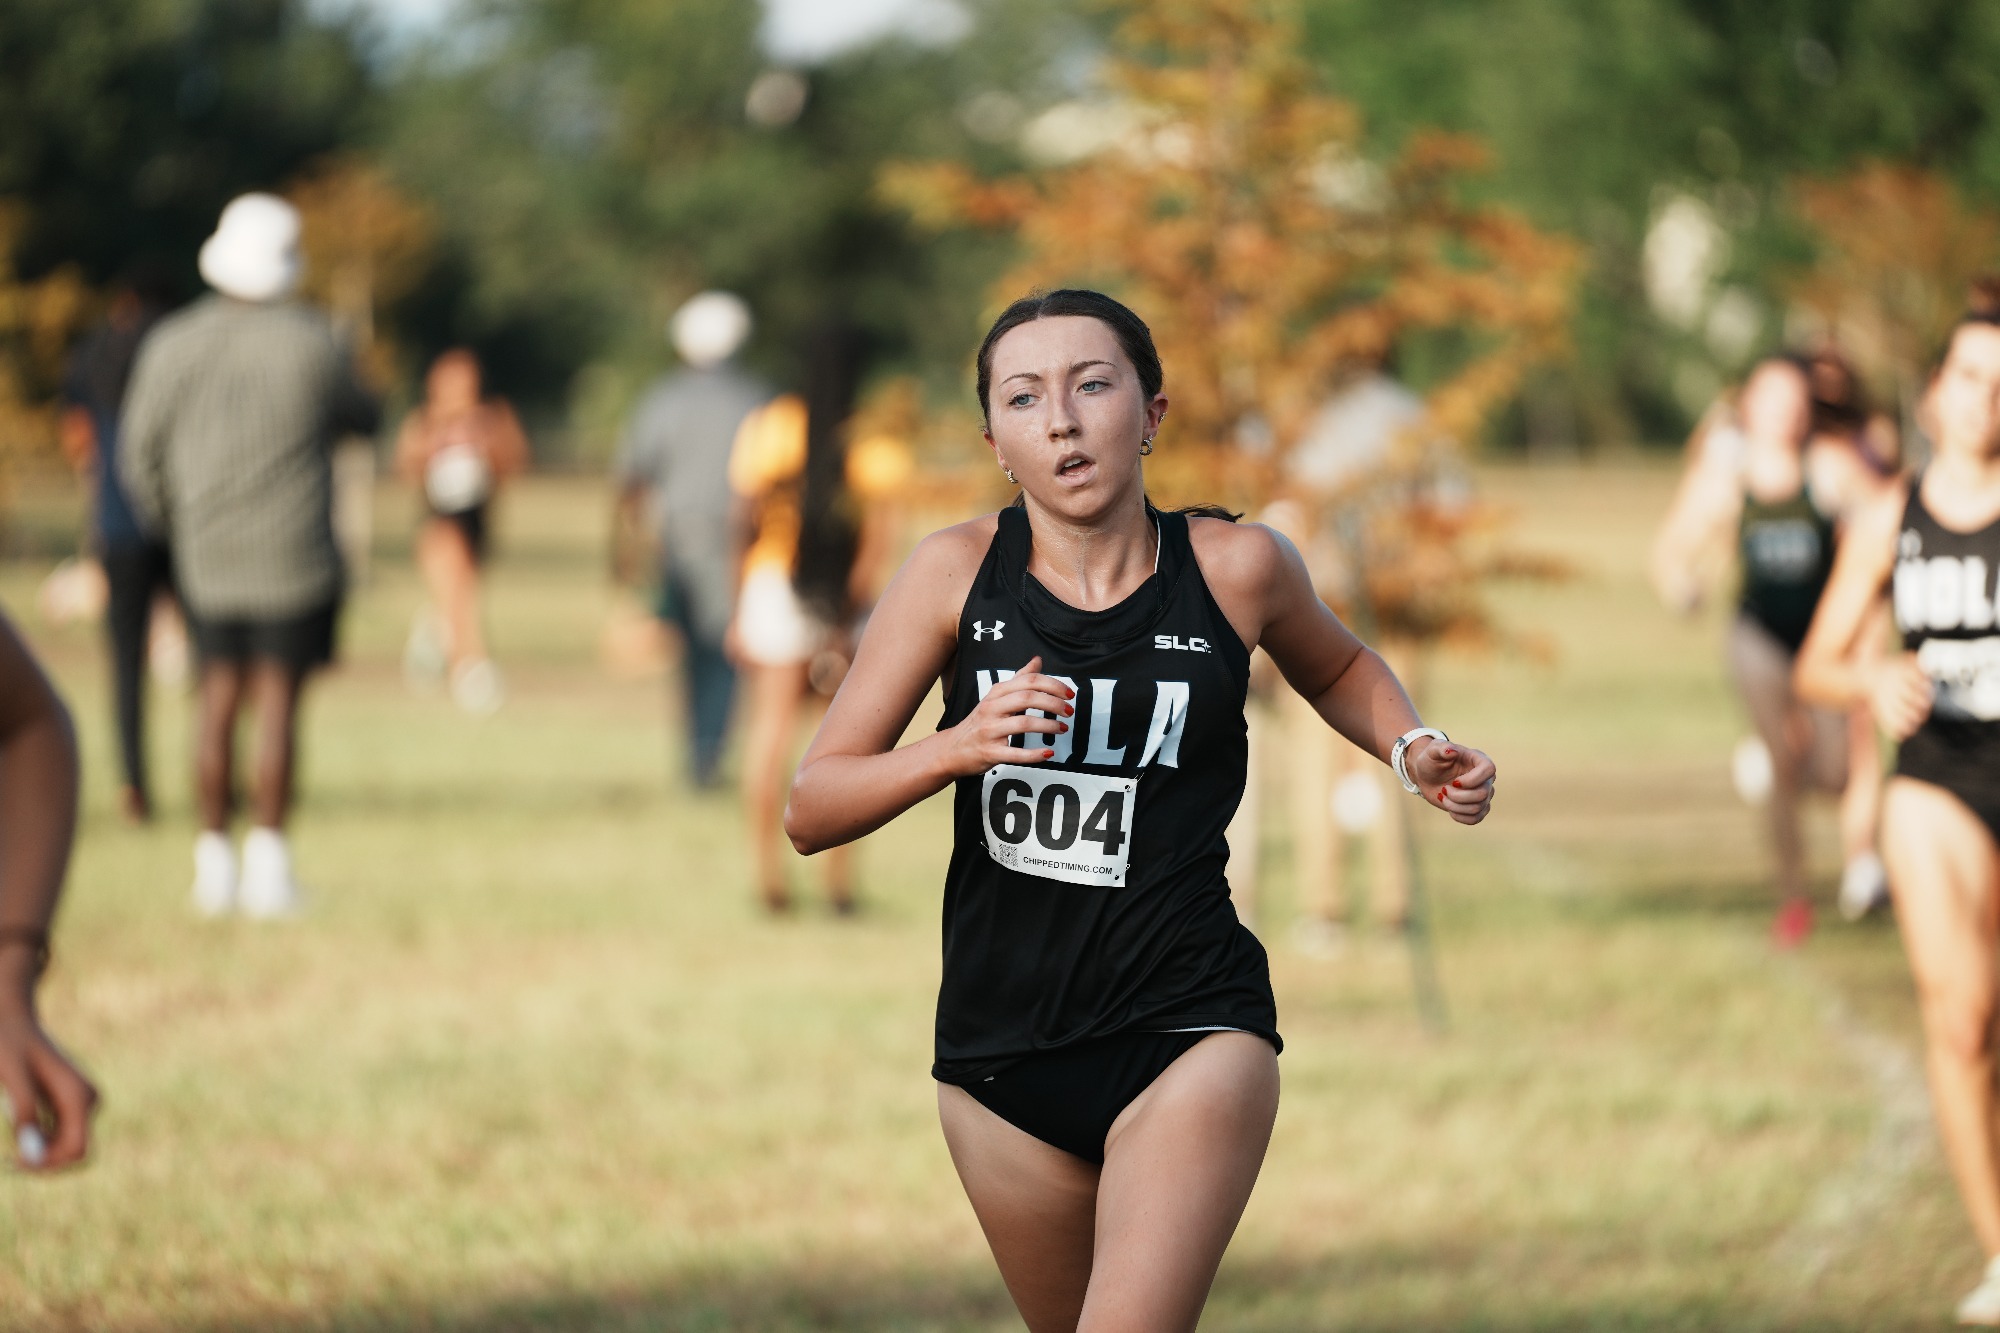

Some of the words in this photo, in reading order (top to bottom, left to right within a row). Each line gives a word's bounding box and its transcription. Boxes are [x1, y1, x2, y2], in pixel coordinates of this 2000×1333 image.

[1894, 556, 2000, 630] NOL
[1154, 634, 1207, 653] SLC
[988, 778, 1127, 856] 604
[1023, 856, 1113, 875] CHIPPEDTIMING.COM
